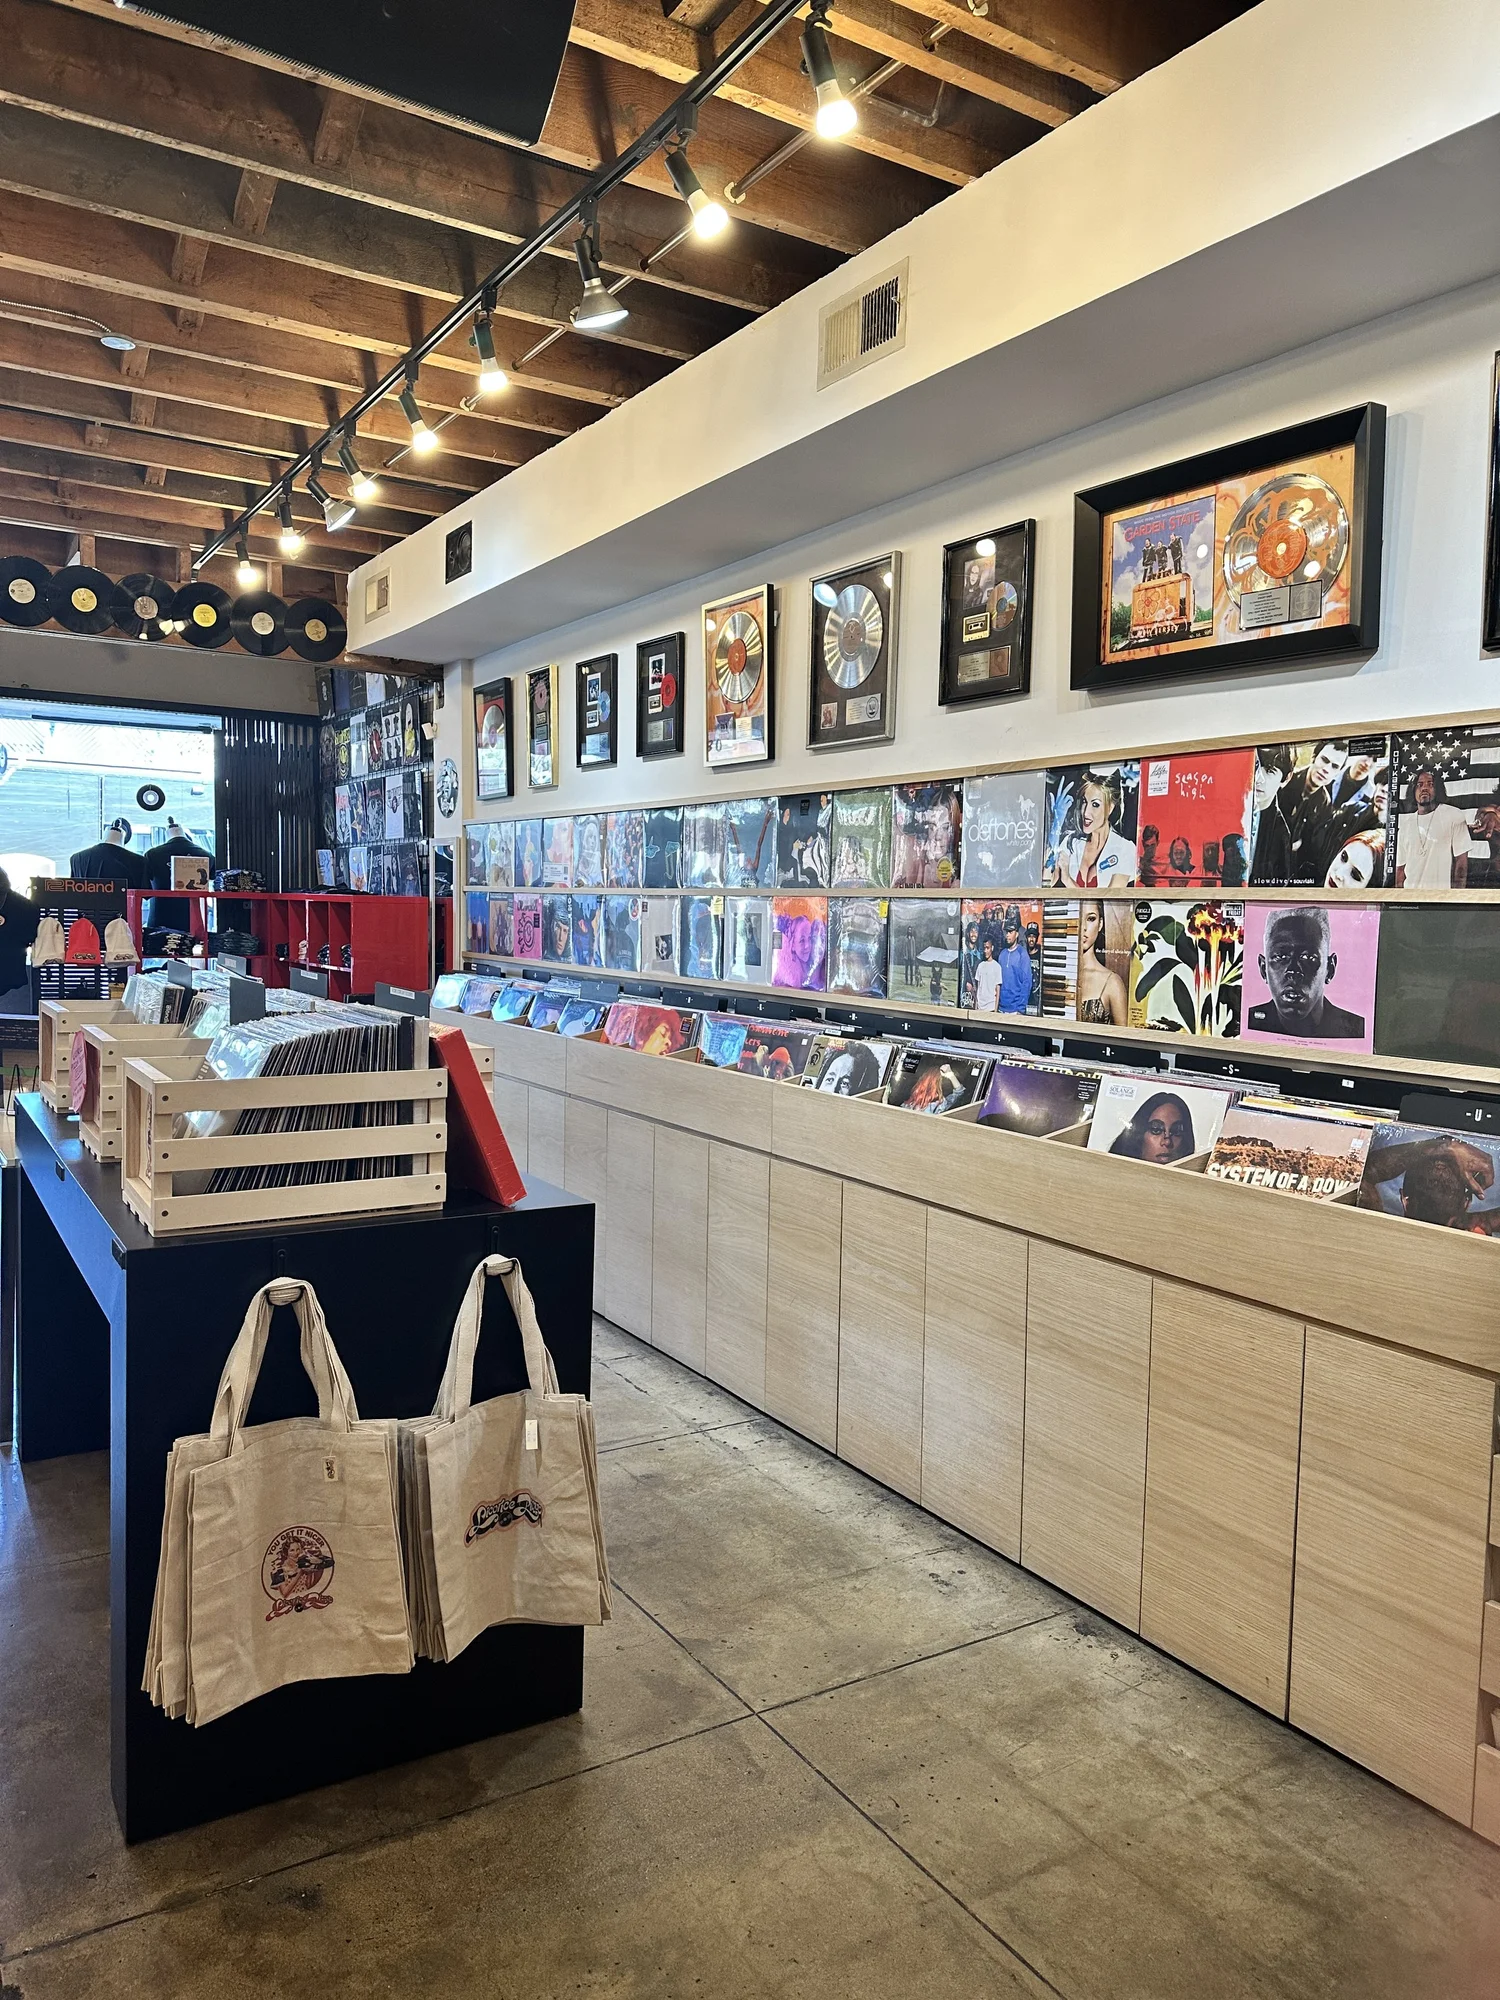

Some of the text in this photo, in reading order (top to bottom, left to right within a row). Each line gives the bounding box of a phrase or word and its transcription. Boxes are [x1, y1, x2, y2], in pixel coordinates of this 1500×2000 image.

[1124, 509, 1201, 542] GARDEN STATE
[1175, 771, 1213, 785] season
[1180, 783, 1206, 800] high
[968, 817, 1035, 842] deftones
[65, 879, 114, 893] Roland
[1253, 877, 1315, 885] slowdive souvlaki
[1110, 1086, 1135, 1095] SOLANGE
[1207, 1162, 1355, 1194] SYSTEM OF A DOW
[268, 1539, 281, 1556] YOU
[281, 1529, 295, 1541] GET
[304, 1530, 325, 1548] NICER
